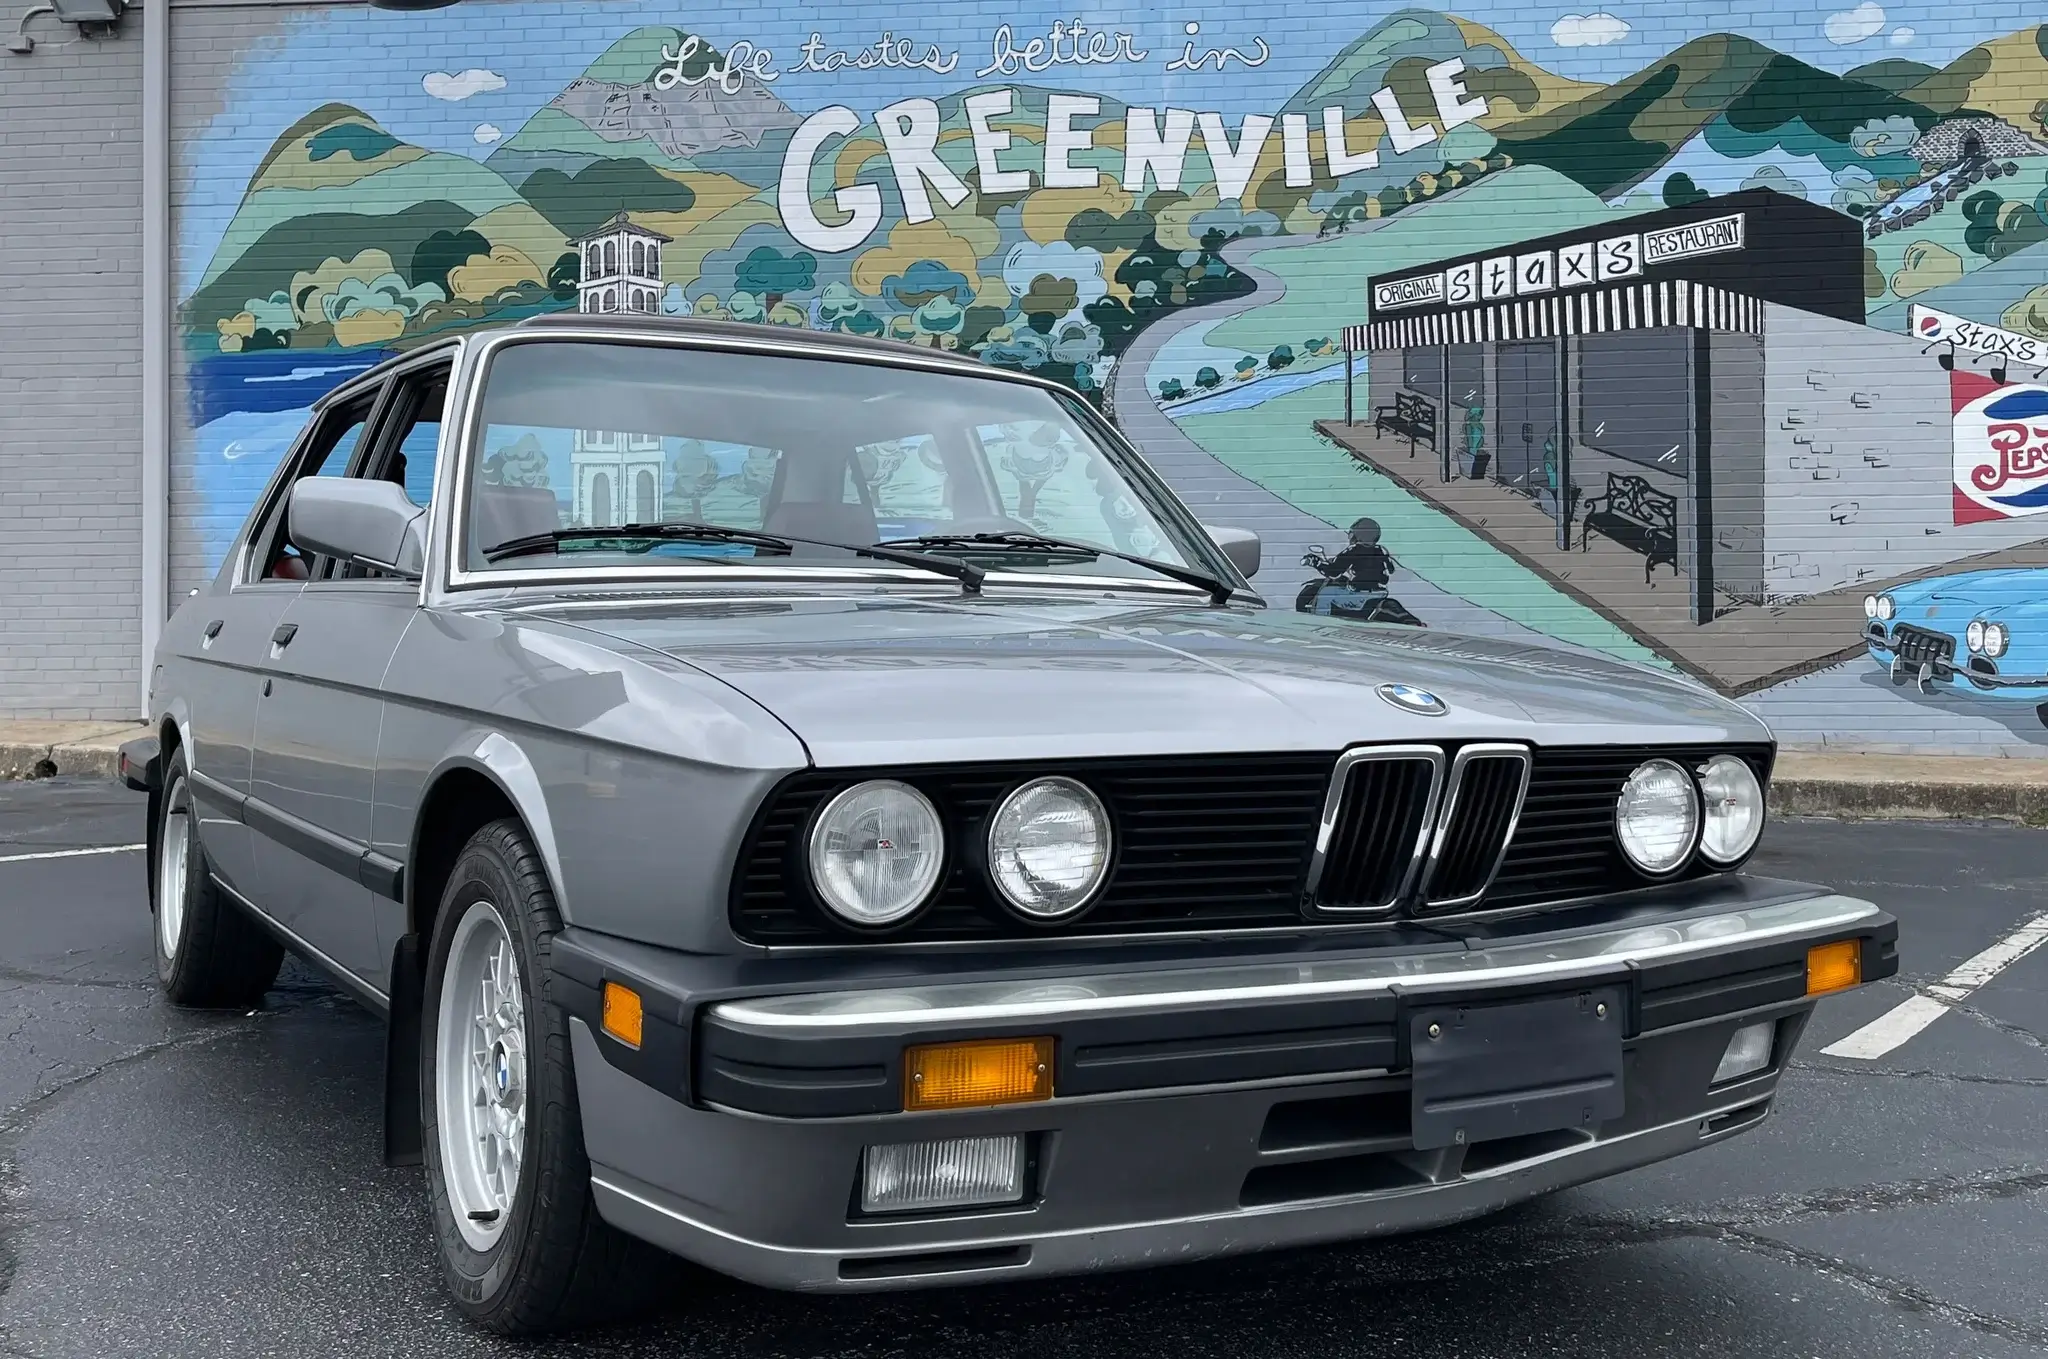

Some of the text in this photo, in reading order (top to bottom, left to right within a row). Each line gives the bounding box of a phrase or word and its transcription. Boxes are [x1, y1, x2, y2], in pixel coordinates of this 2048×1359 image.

[653, 18, 1269, 95] Life tastes better in
[777, 56, 1490, 253] GREENVILLE
[1379, 278, 1441, 304] ORIGINAL
[1647, 219, 1739, 258] RESTAURANT
